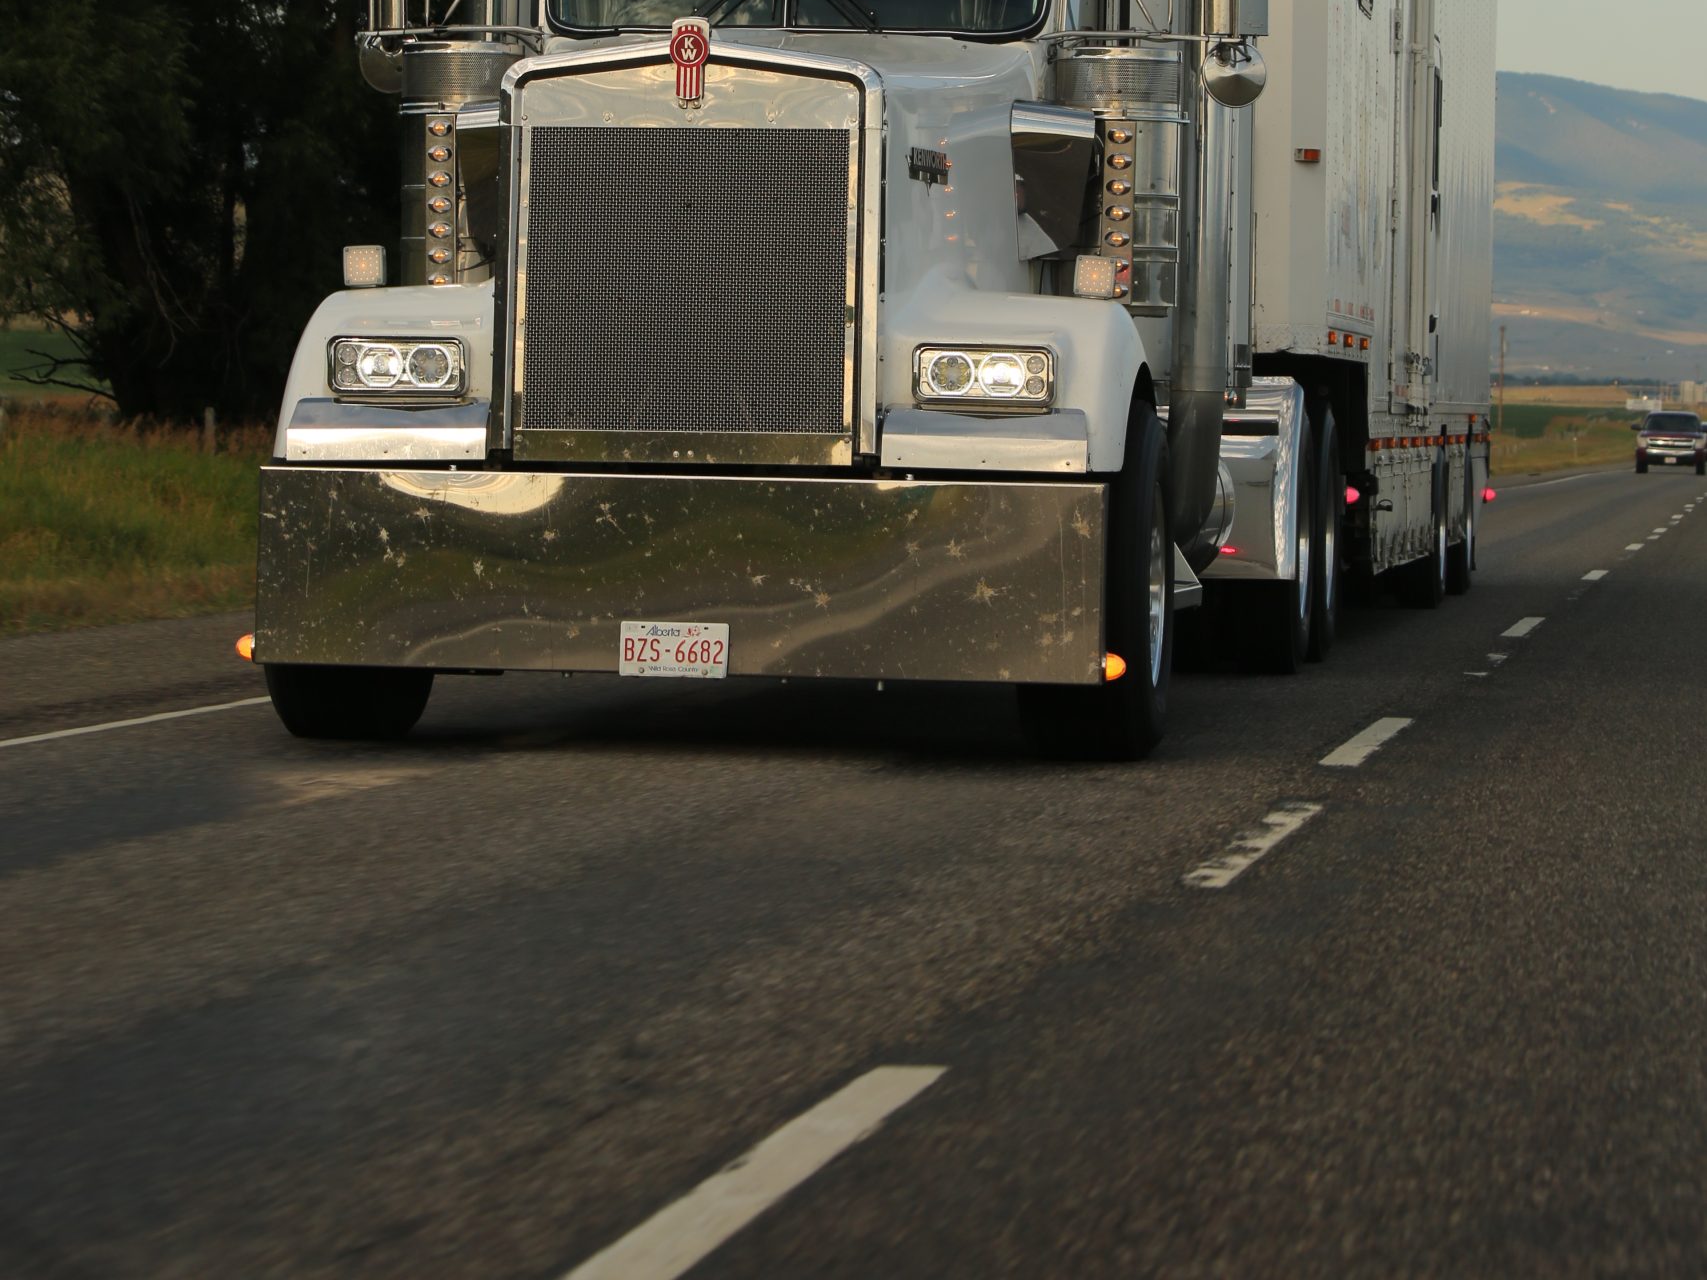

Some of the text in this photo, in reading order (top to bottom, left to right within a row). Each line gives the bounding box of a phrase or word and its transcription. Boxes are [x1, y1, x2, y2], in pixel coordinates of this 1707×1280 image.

[684, 37, 695, 49] K
[680, 48, 698, 61] W
[645, 624, 681, 637] Alberta
[624, 637, 724, 665] BZS-6682
